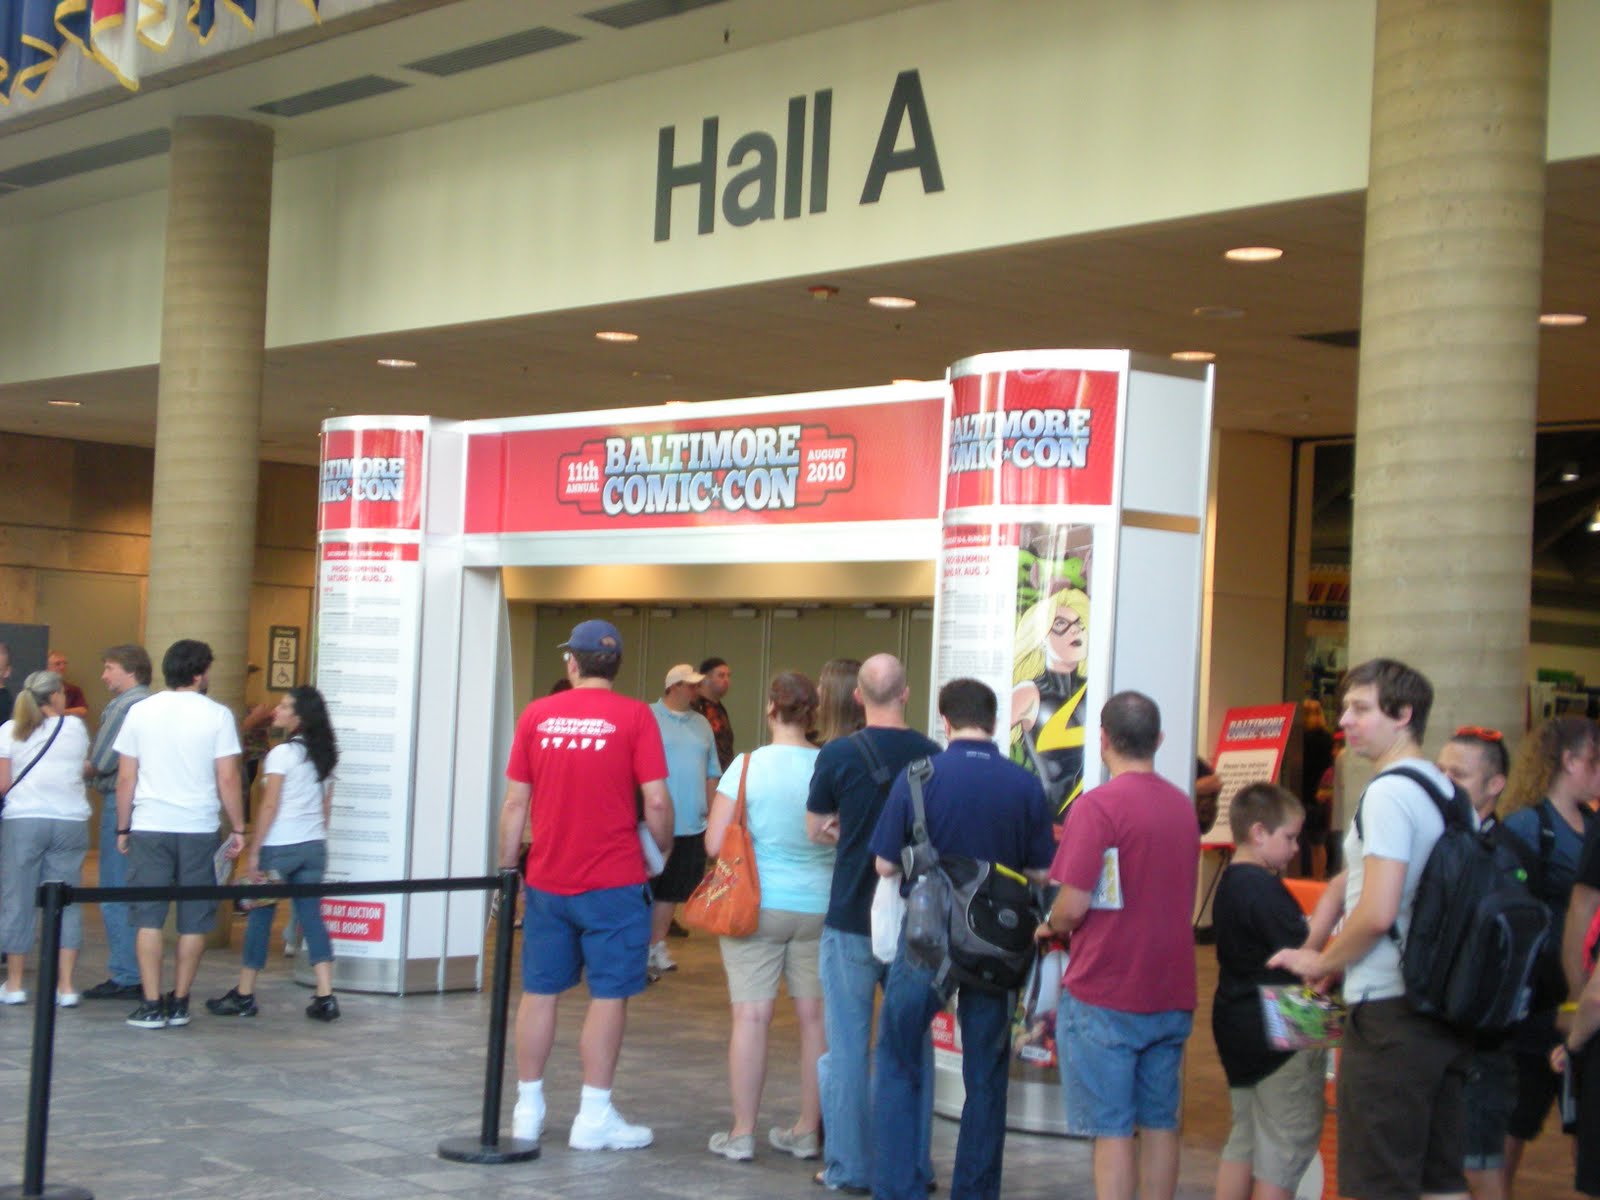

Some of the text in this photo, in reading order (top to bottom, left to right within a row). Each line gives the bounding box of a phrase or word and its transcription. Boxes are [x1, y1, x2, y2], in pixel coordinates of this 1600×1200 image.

[654, 68, 945, 243] Hall A
[604, 425, 801, 475] BALTIMORE
[806, 447, 847, 461] AUGUST
[1012, 436, 1089, 470] CON
[567, 460, 599, 482] 11th
[806, 461, 846, 483] 2010
[351, 477, 404, 502] CON
[565, 483, 600, 494] ANNUAL
[602, 466, 800, 516] COMIC CON
[333, 904, 347, 917] ART
[347, 906, 381, 920] AUCTION
[342, 922, 369, 935] ROOMS
